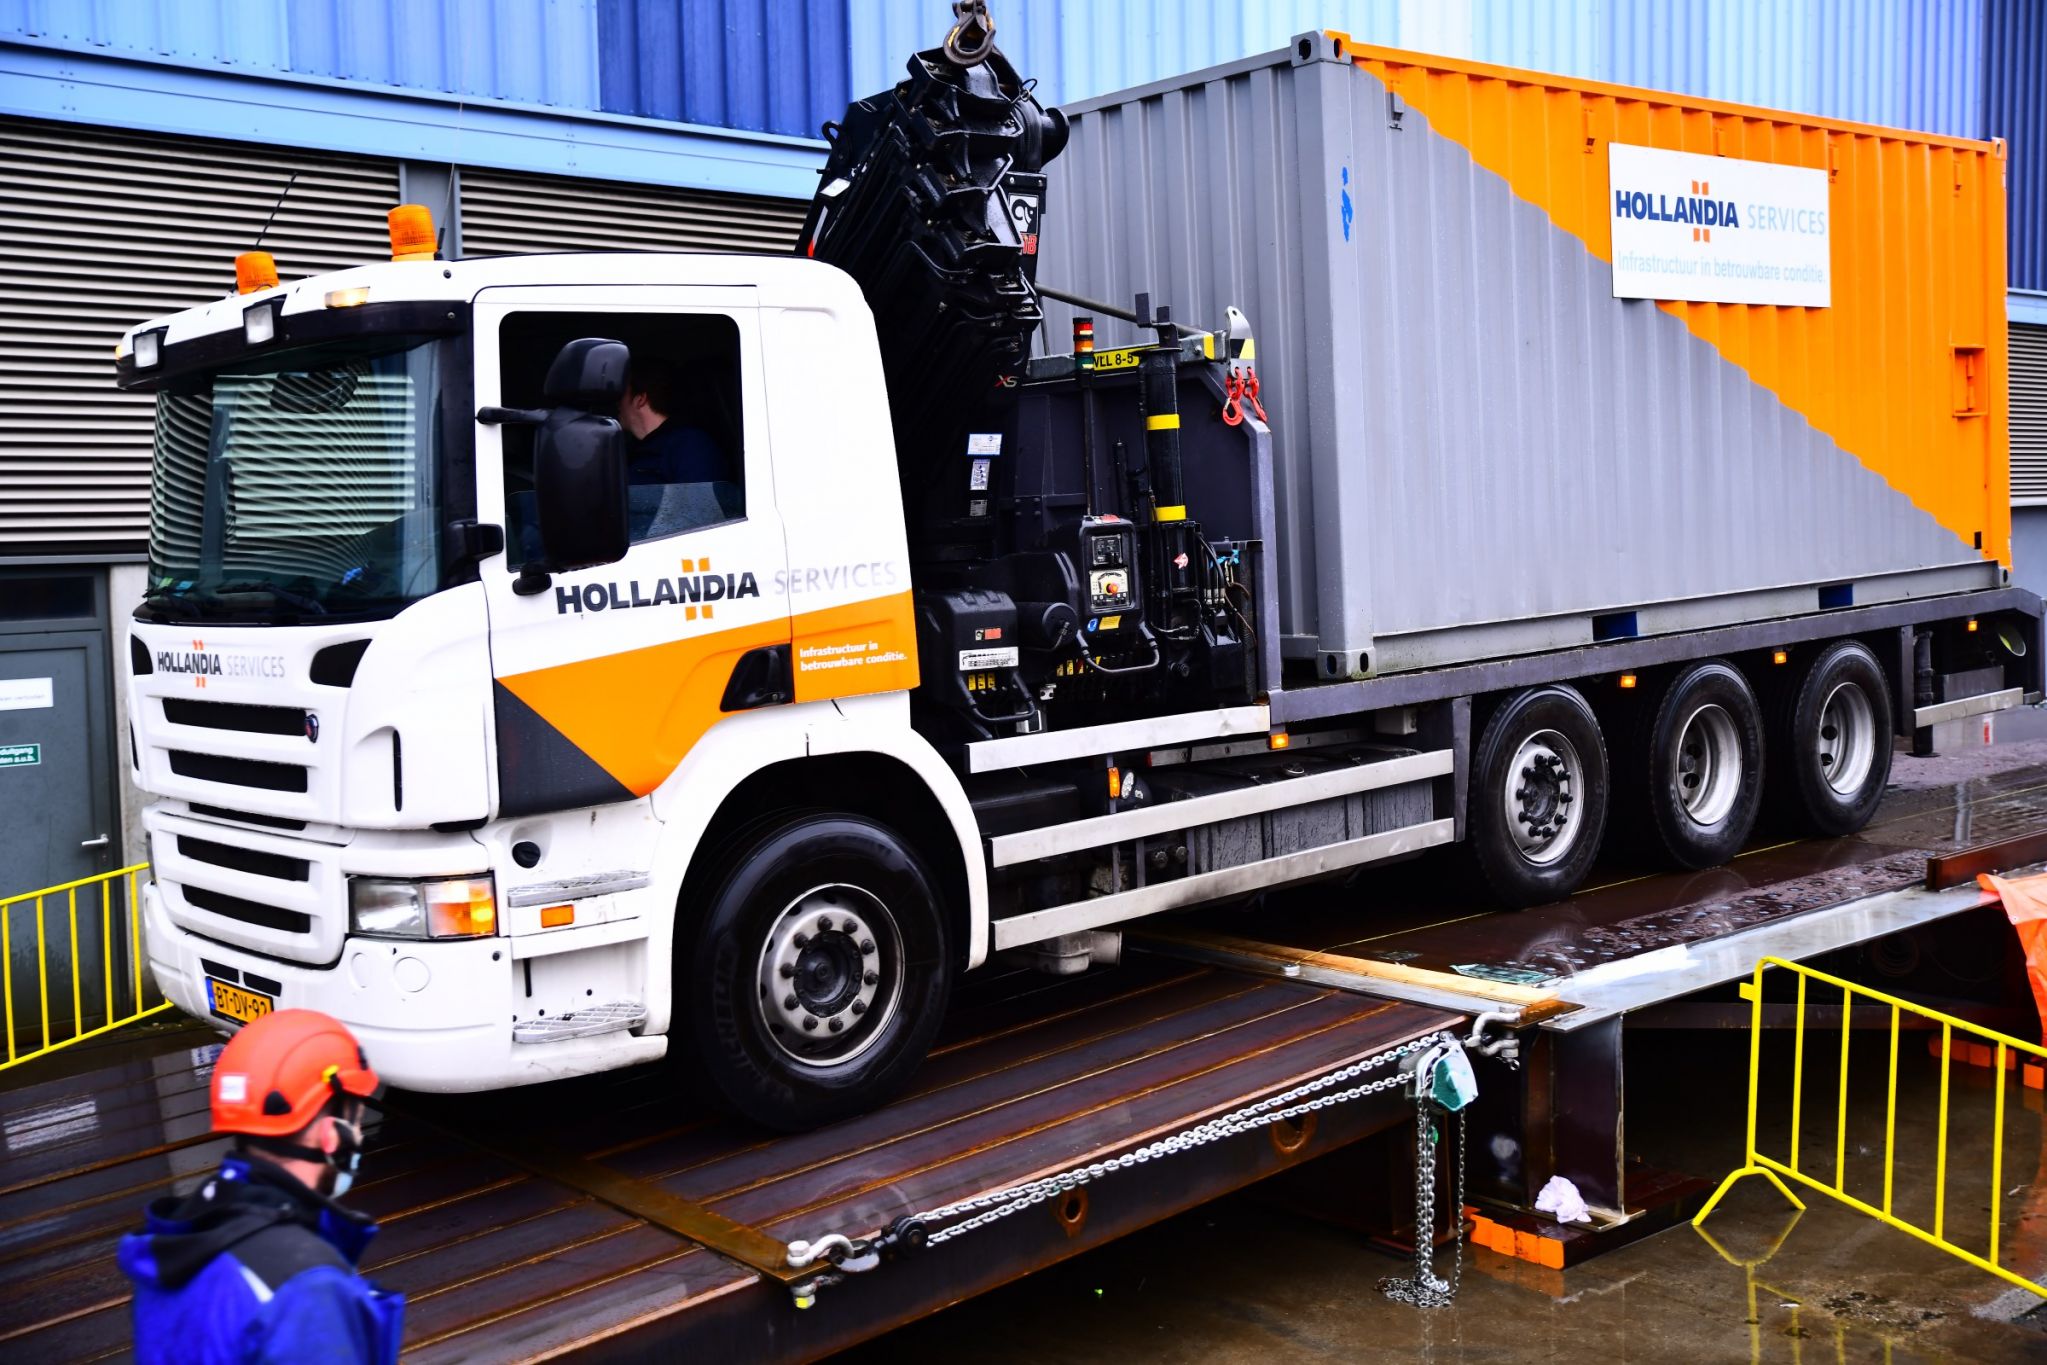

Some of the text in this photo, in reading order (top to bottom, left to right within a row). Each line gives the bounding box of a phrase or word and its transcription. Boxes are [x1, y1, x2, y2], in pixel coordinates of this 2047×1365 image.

[1615, 190, 1825, 236] HOLLANDIA SERVICES
[1618, 250, 1827, 284] Infrastructuur in betrouwbare conditie.
[555, 561, 897, 615] HOLLANDIA SERVICES
[799, 640, 878, 658] Infrastructuur in
[800, 651, 908, 672] betrouwbare conditie.
[157, 651, 286, 678] HOLLANDIA SERVICES
